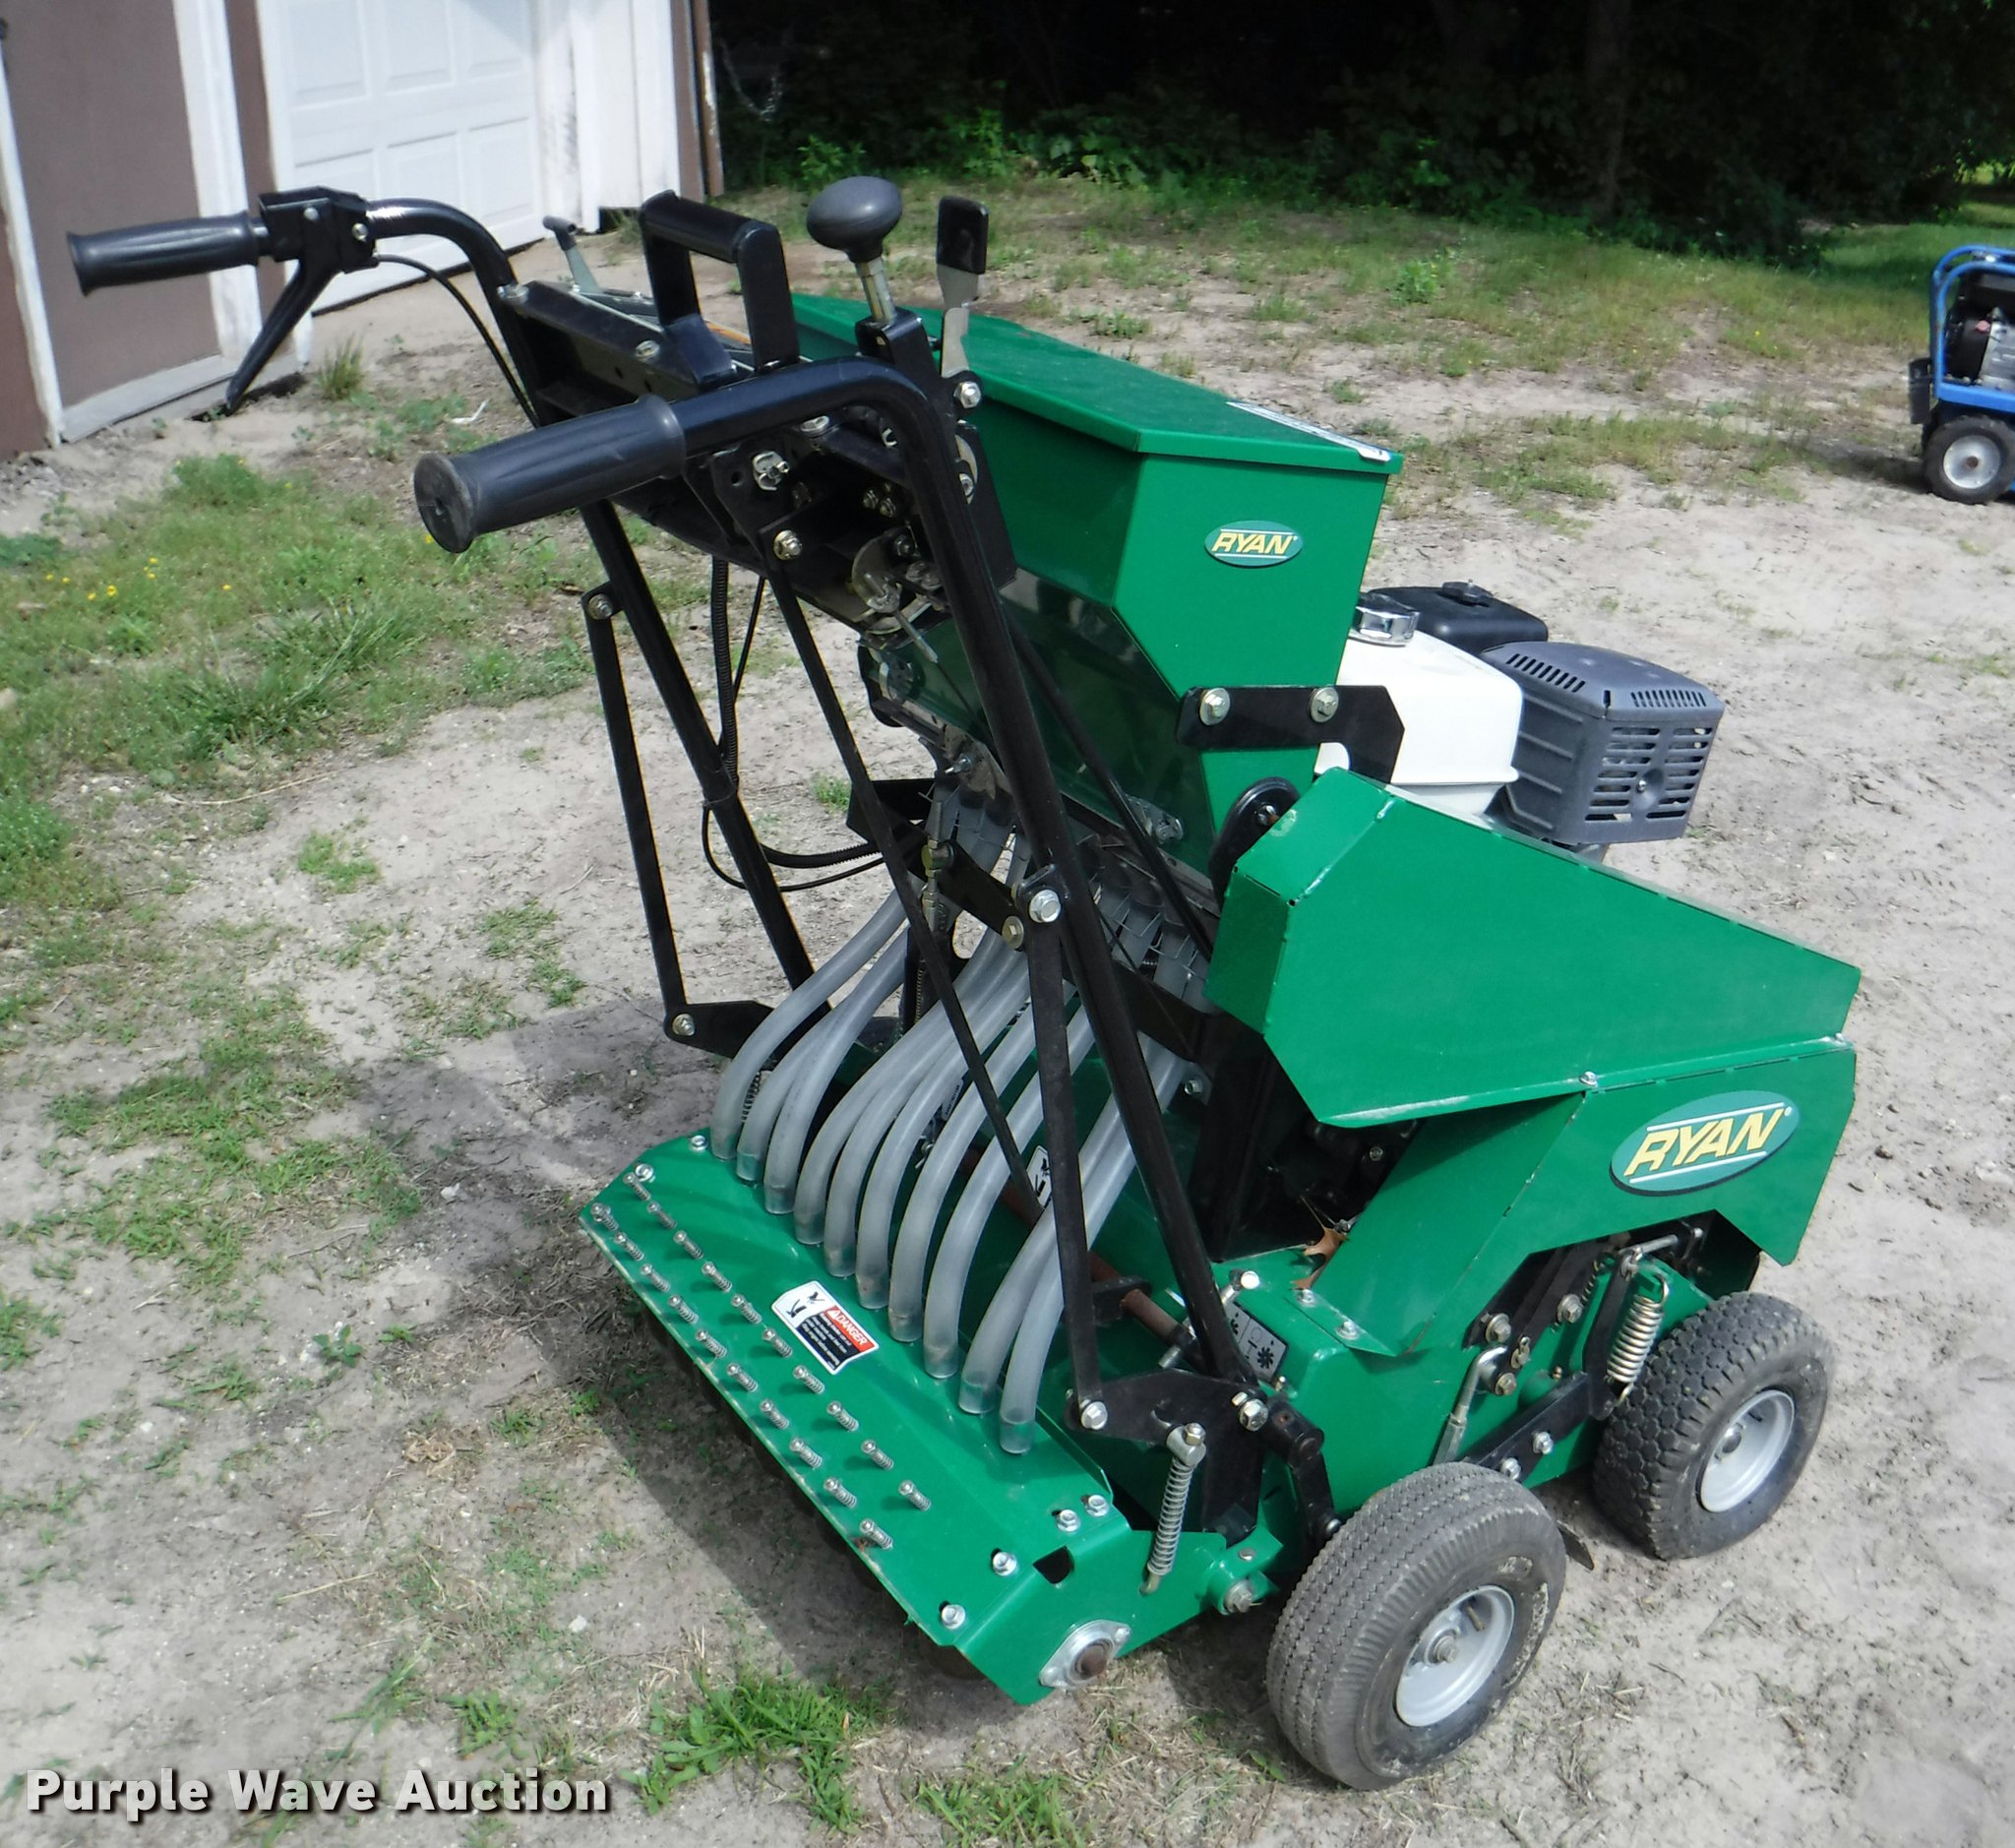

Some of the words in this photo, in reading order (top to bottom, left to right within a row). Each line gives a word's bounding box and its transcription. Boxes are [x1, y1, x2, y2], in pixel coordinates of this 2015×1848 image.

[1211, 531, 1294, 555] RYAN
[1624, 1107, 1786, 1176] RYAN
[835, 1314, 868, 1345] DANGER
